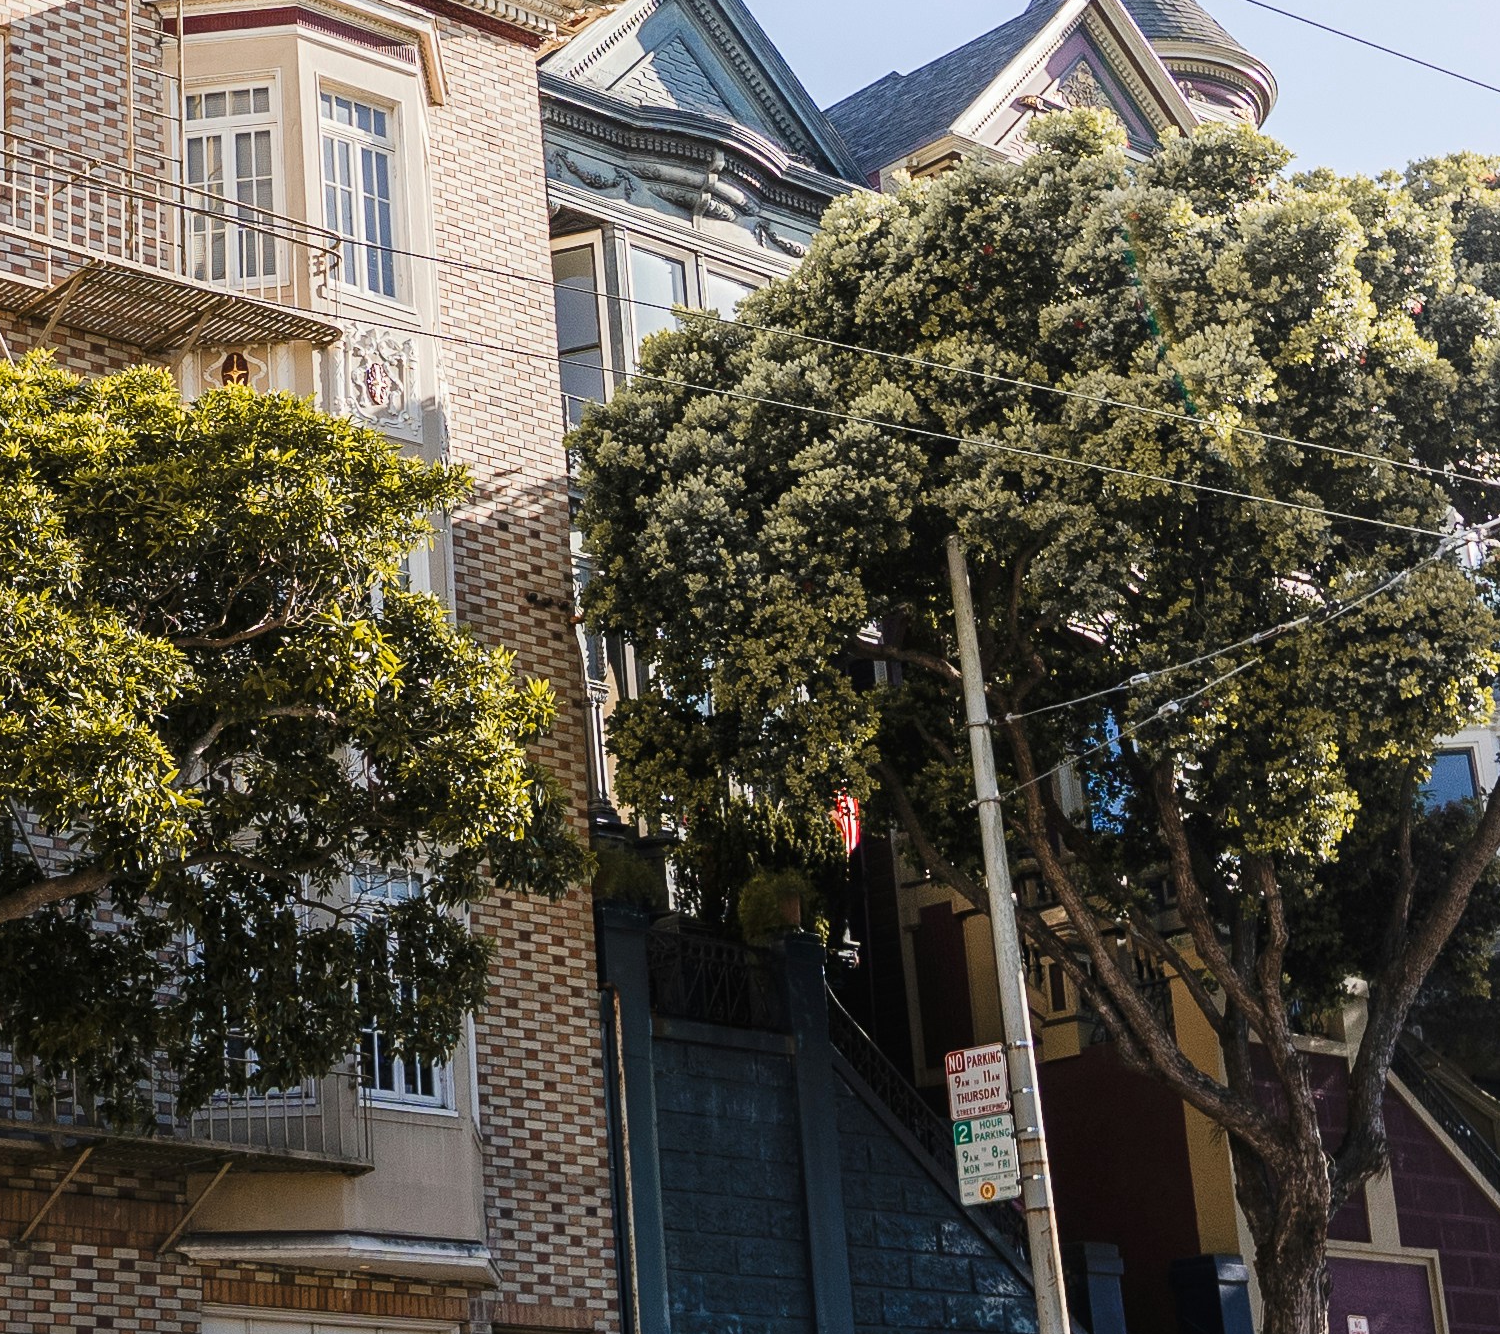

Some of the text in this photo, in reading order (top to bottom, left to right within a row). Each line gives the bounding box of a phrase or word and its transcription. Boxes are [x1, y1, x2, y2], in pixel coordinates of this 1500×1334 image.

[948, 1050, 1001, 1072] NO PARKING
[957, 1086, 1000, 1104] THURSDAY
[956, 1107, 976, 1117] STREET
[958, 1117, 1003, 1142] 2 HOUR
[975, 1128, 1010, 1142] PARKING
[964, 1164, 980, 1175] MON
[998, 1159, 1010, 1169] FRI
